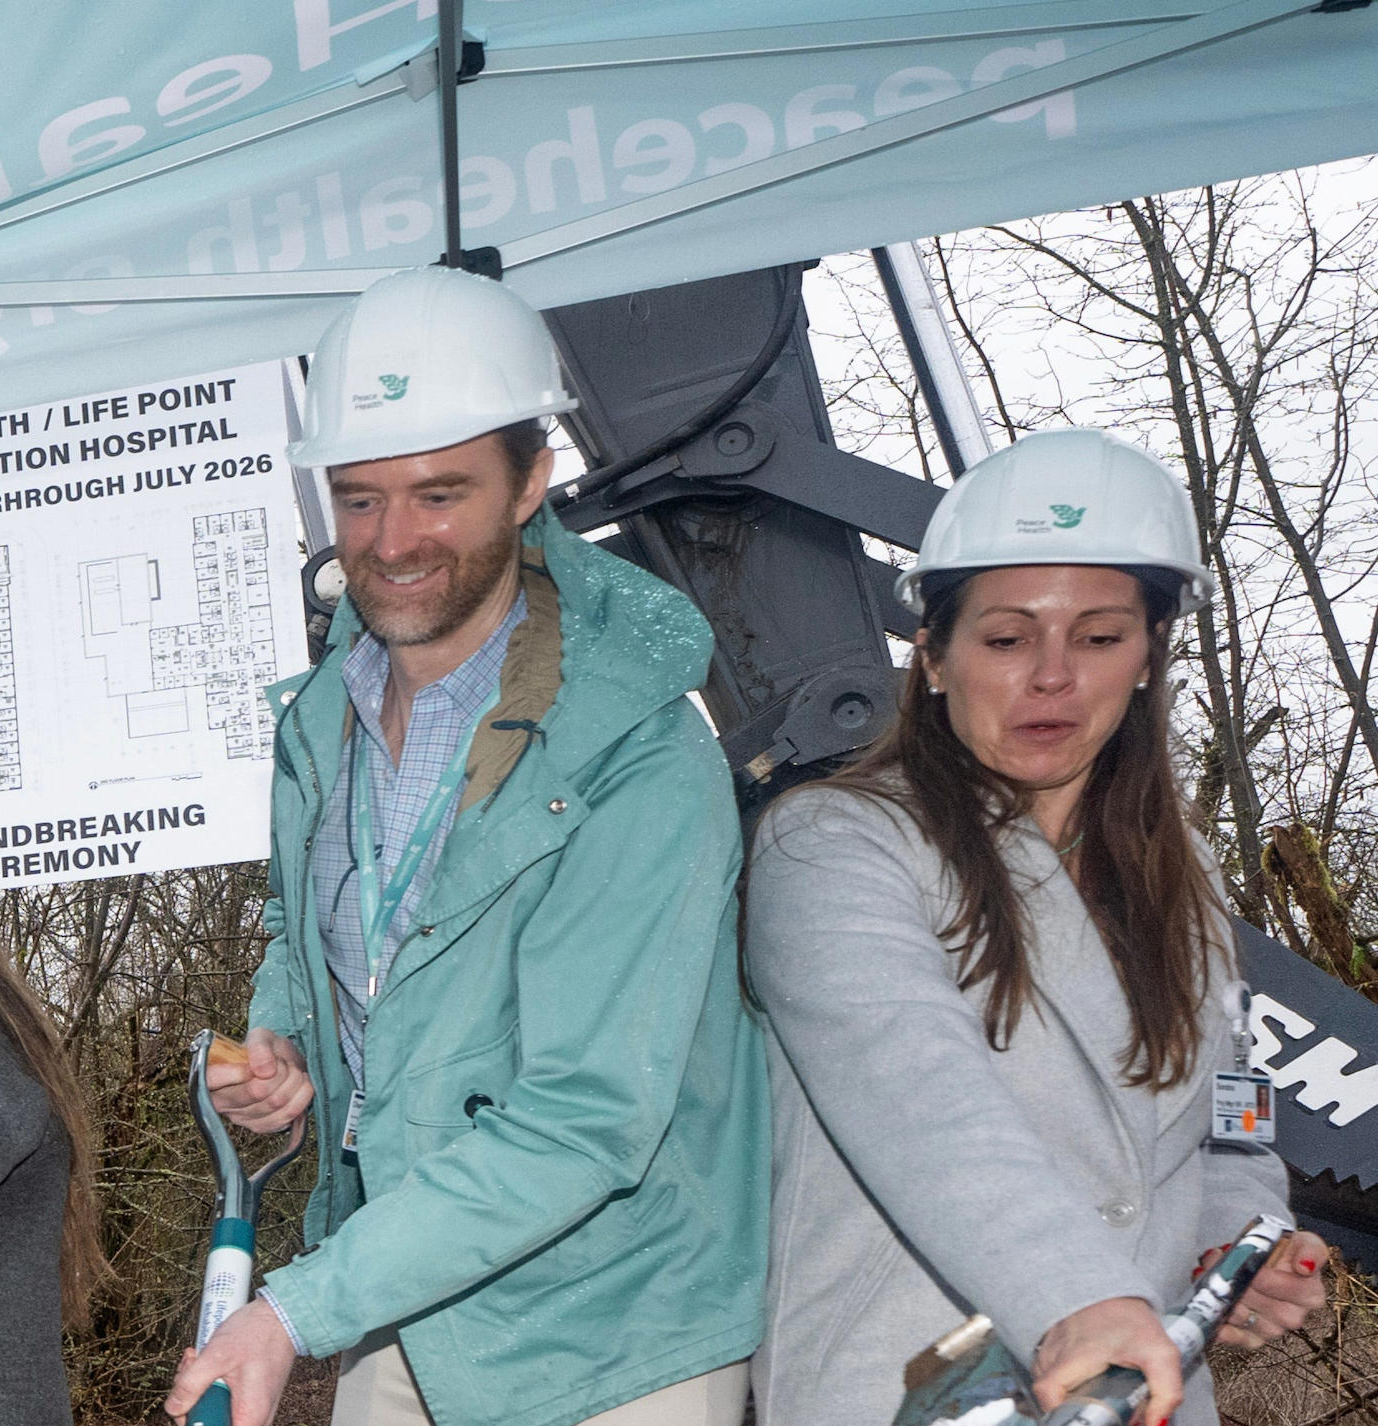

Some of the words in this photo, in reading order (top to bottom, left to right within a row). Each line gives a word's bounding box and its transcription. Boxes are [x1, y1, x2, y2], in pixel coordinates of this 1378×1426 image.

[43, 408, 53, 431] /
[63, 397, 129, 428] LIFE
[138, 378, 237, 415] POINT
[80, 417, 237, 462] HOSPITAL
[133, 462, 197, 492] JULY
[203, 454, 273, 483] 2026
